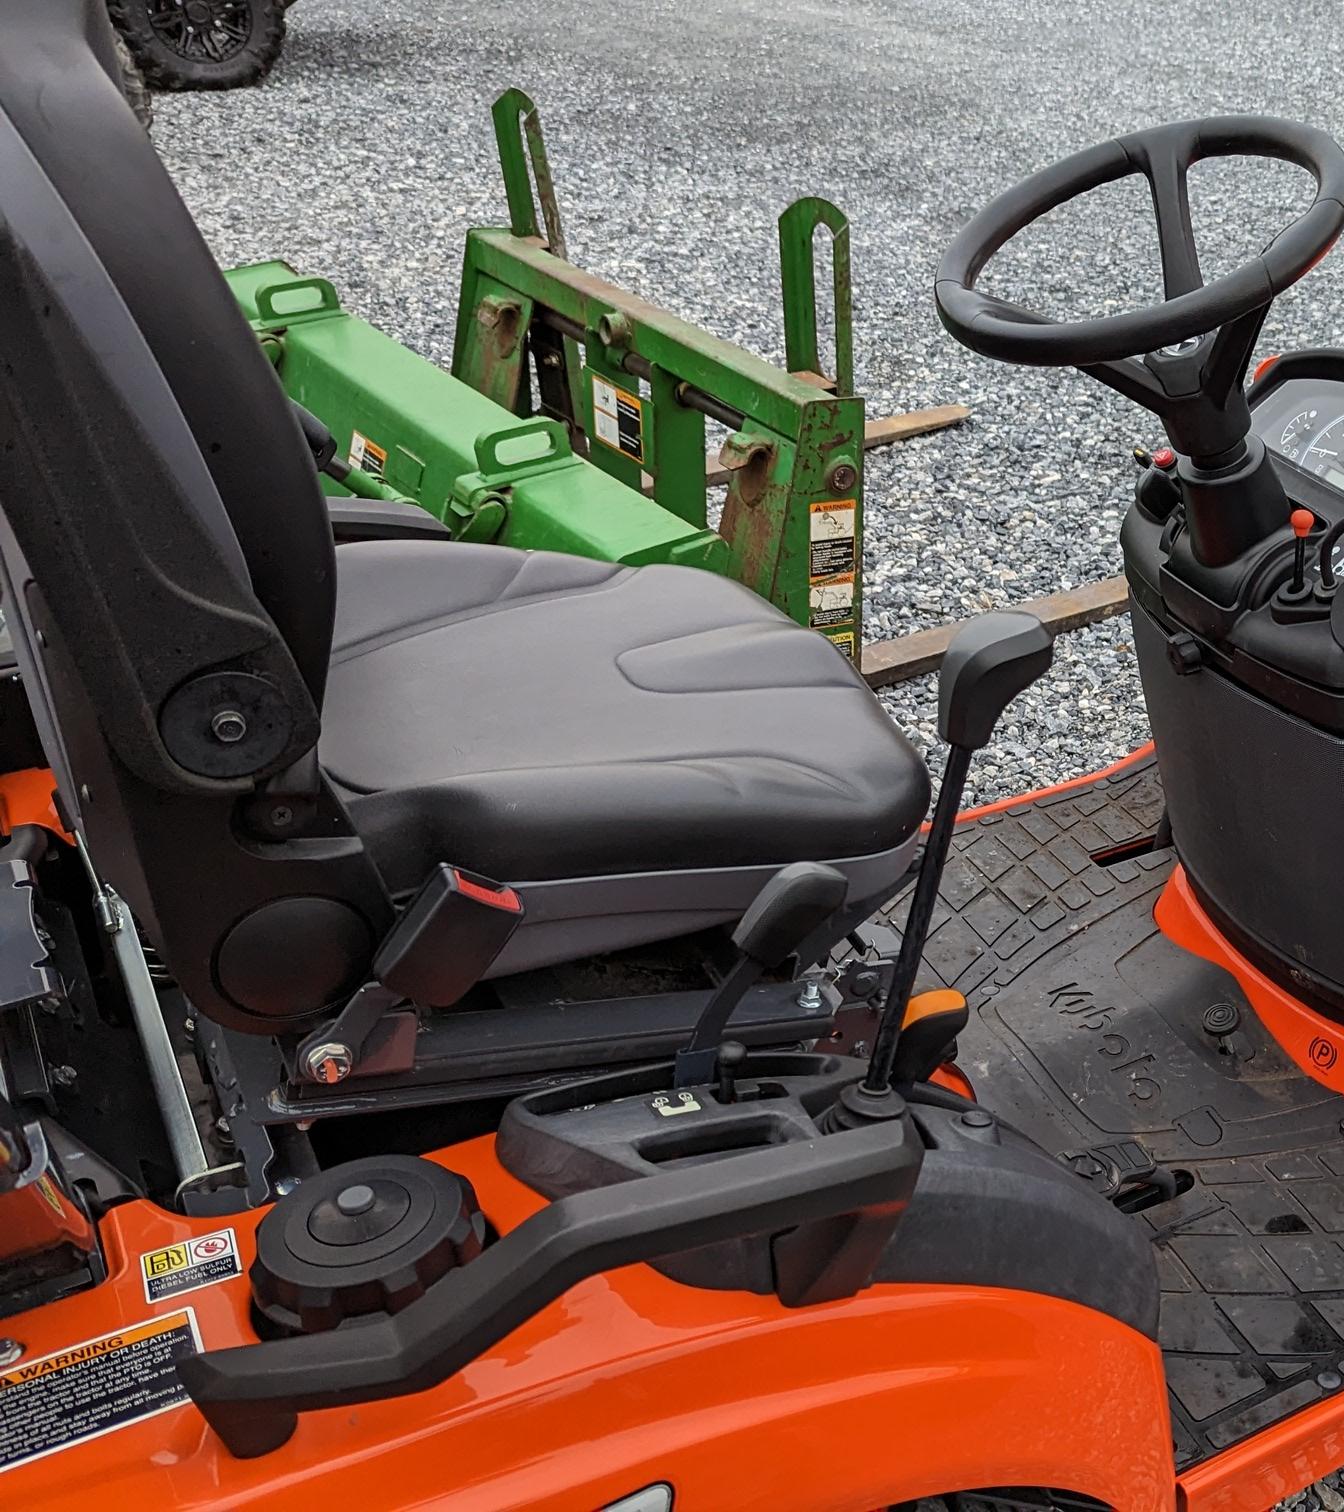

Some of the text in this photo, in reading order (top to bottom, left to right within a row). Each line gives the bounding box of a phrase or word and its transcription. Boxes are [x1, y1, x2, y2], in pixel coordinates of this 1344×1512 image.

[1047, 982, 1161, 1100] Kubota
[150, 1274, 177, 1287] ULTRA
[179, 1268, 198, 1279] LOW
[199, 1257, 232, 1272] SULFUR
[152, 1280, 184, 1293] DIESEL
[185, 1271, 209, 1283] FUEL
[209, 1262, 233, 1275] ONLY
[0, 1370, 60, 1398] ERSONAL
[62, 1354, 107, 1375] INJURY
[109, 1347, 129, 1359] OR
[18, 1335, 123, 1380] WARNING
